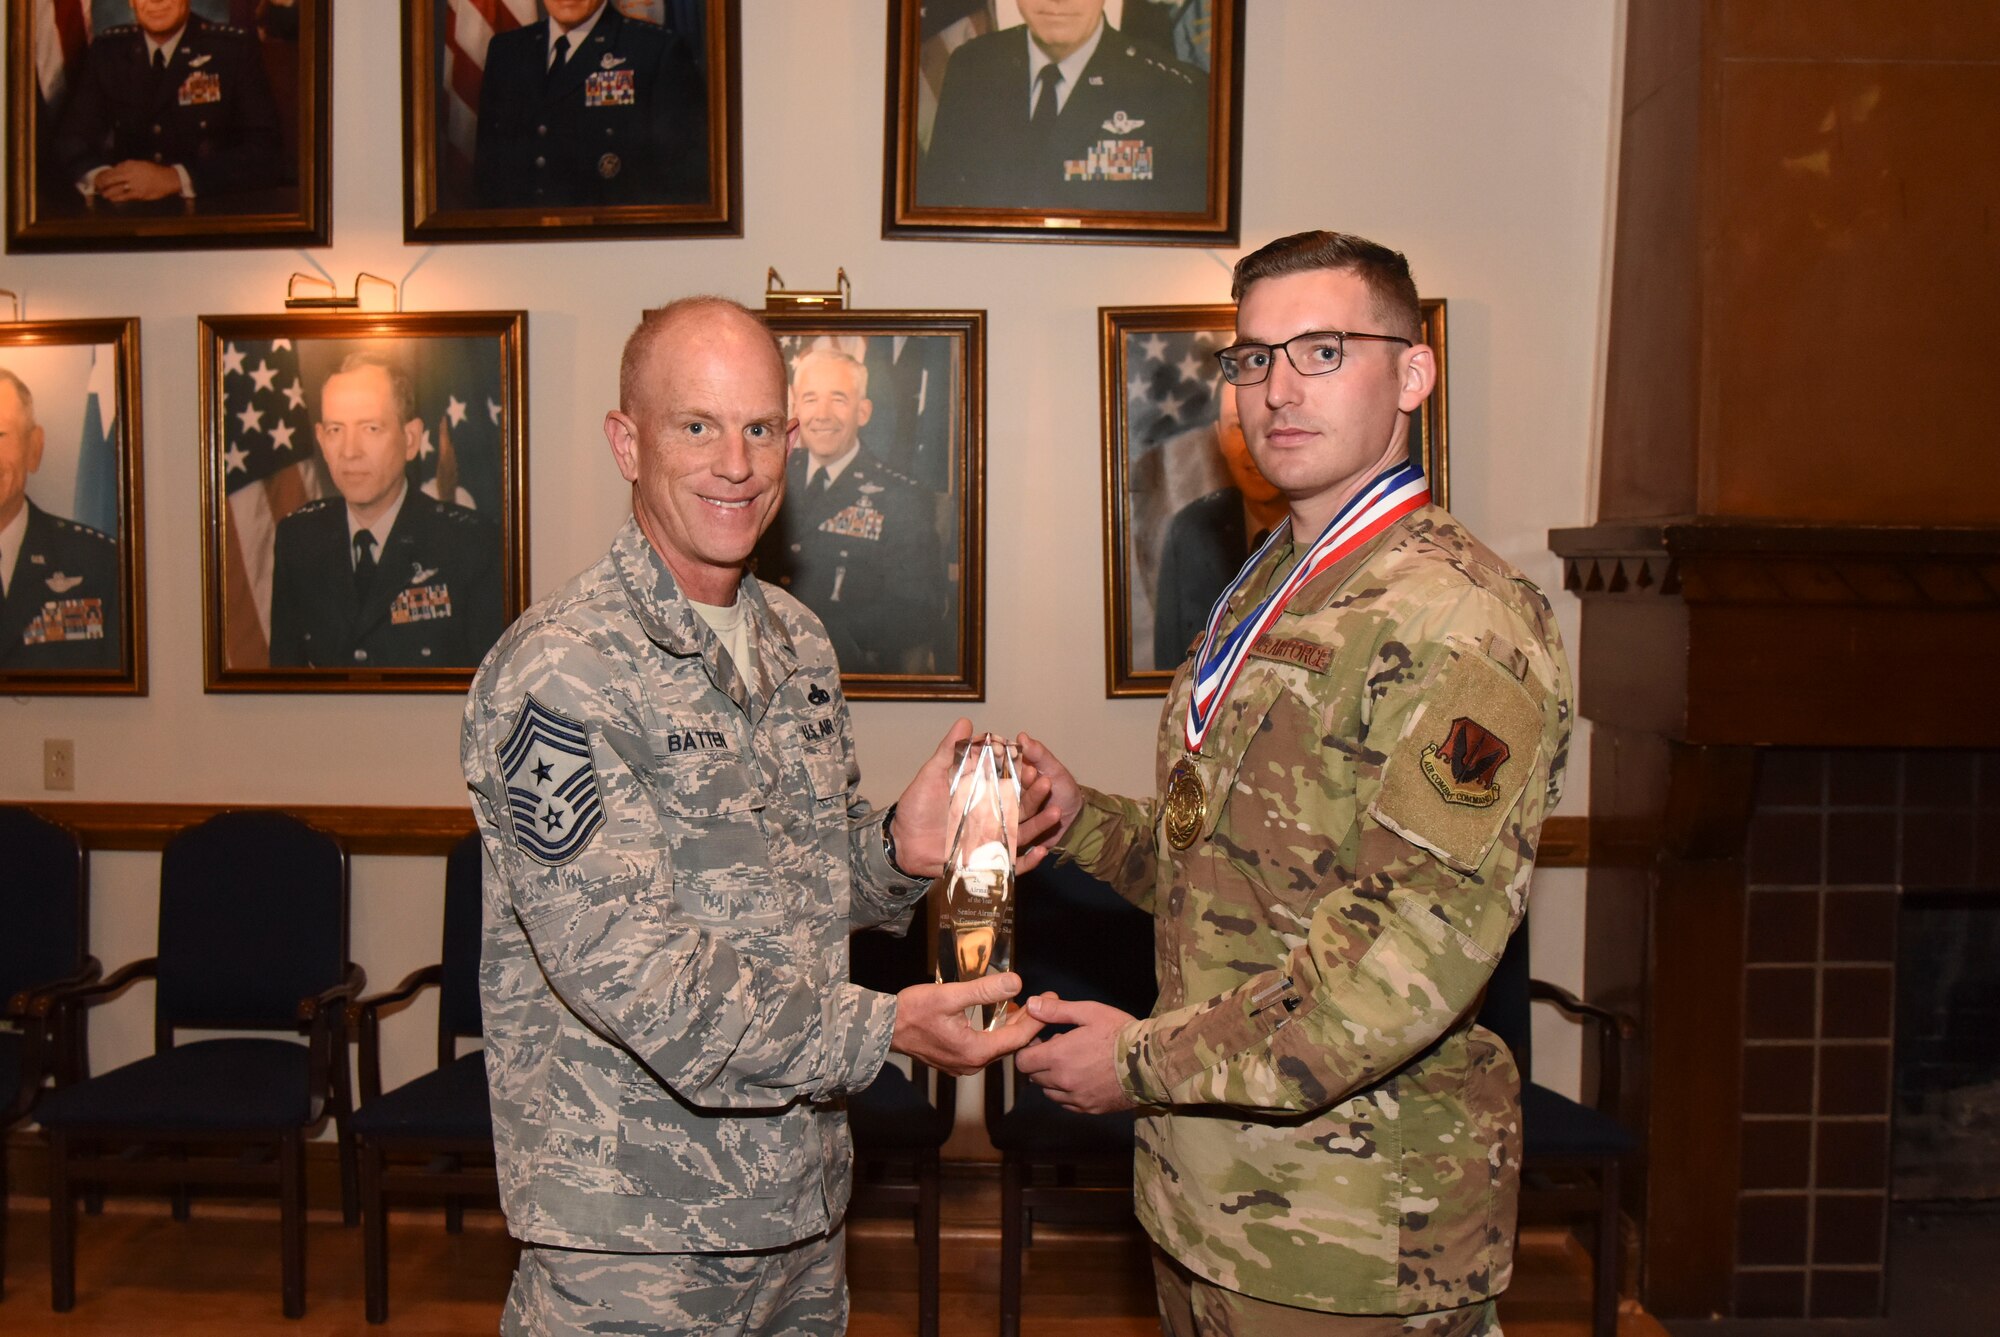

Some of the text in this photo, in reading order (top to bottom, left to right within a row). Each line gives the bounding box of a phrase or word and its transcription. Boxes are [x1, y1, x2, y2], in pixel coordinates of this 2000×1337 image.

[1284, 641, 1329, 668] FORCE
[667, 730, 728, 752] BATTEN
[801, 718, 836, 741] U.S. AIR
[1424, 761, 1492, 804] AIR COMBAT COMMAND
[957, 907, 977, 916] Senior
